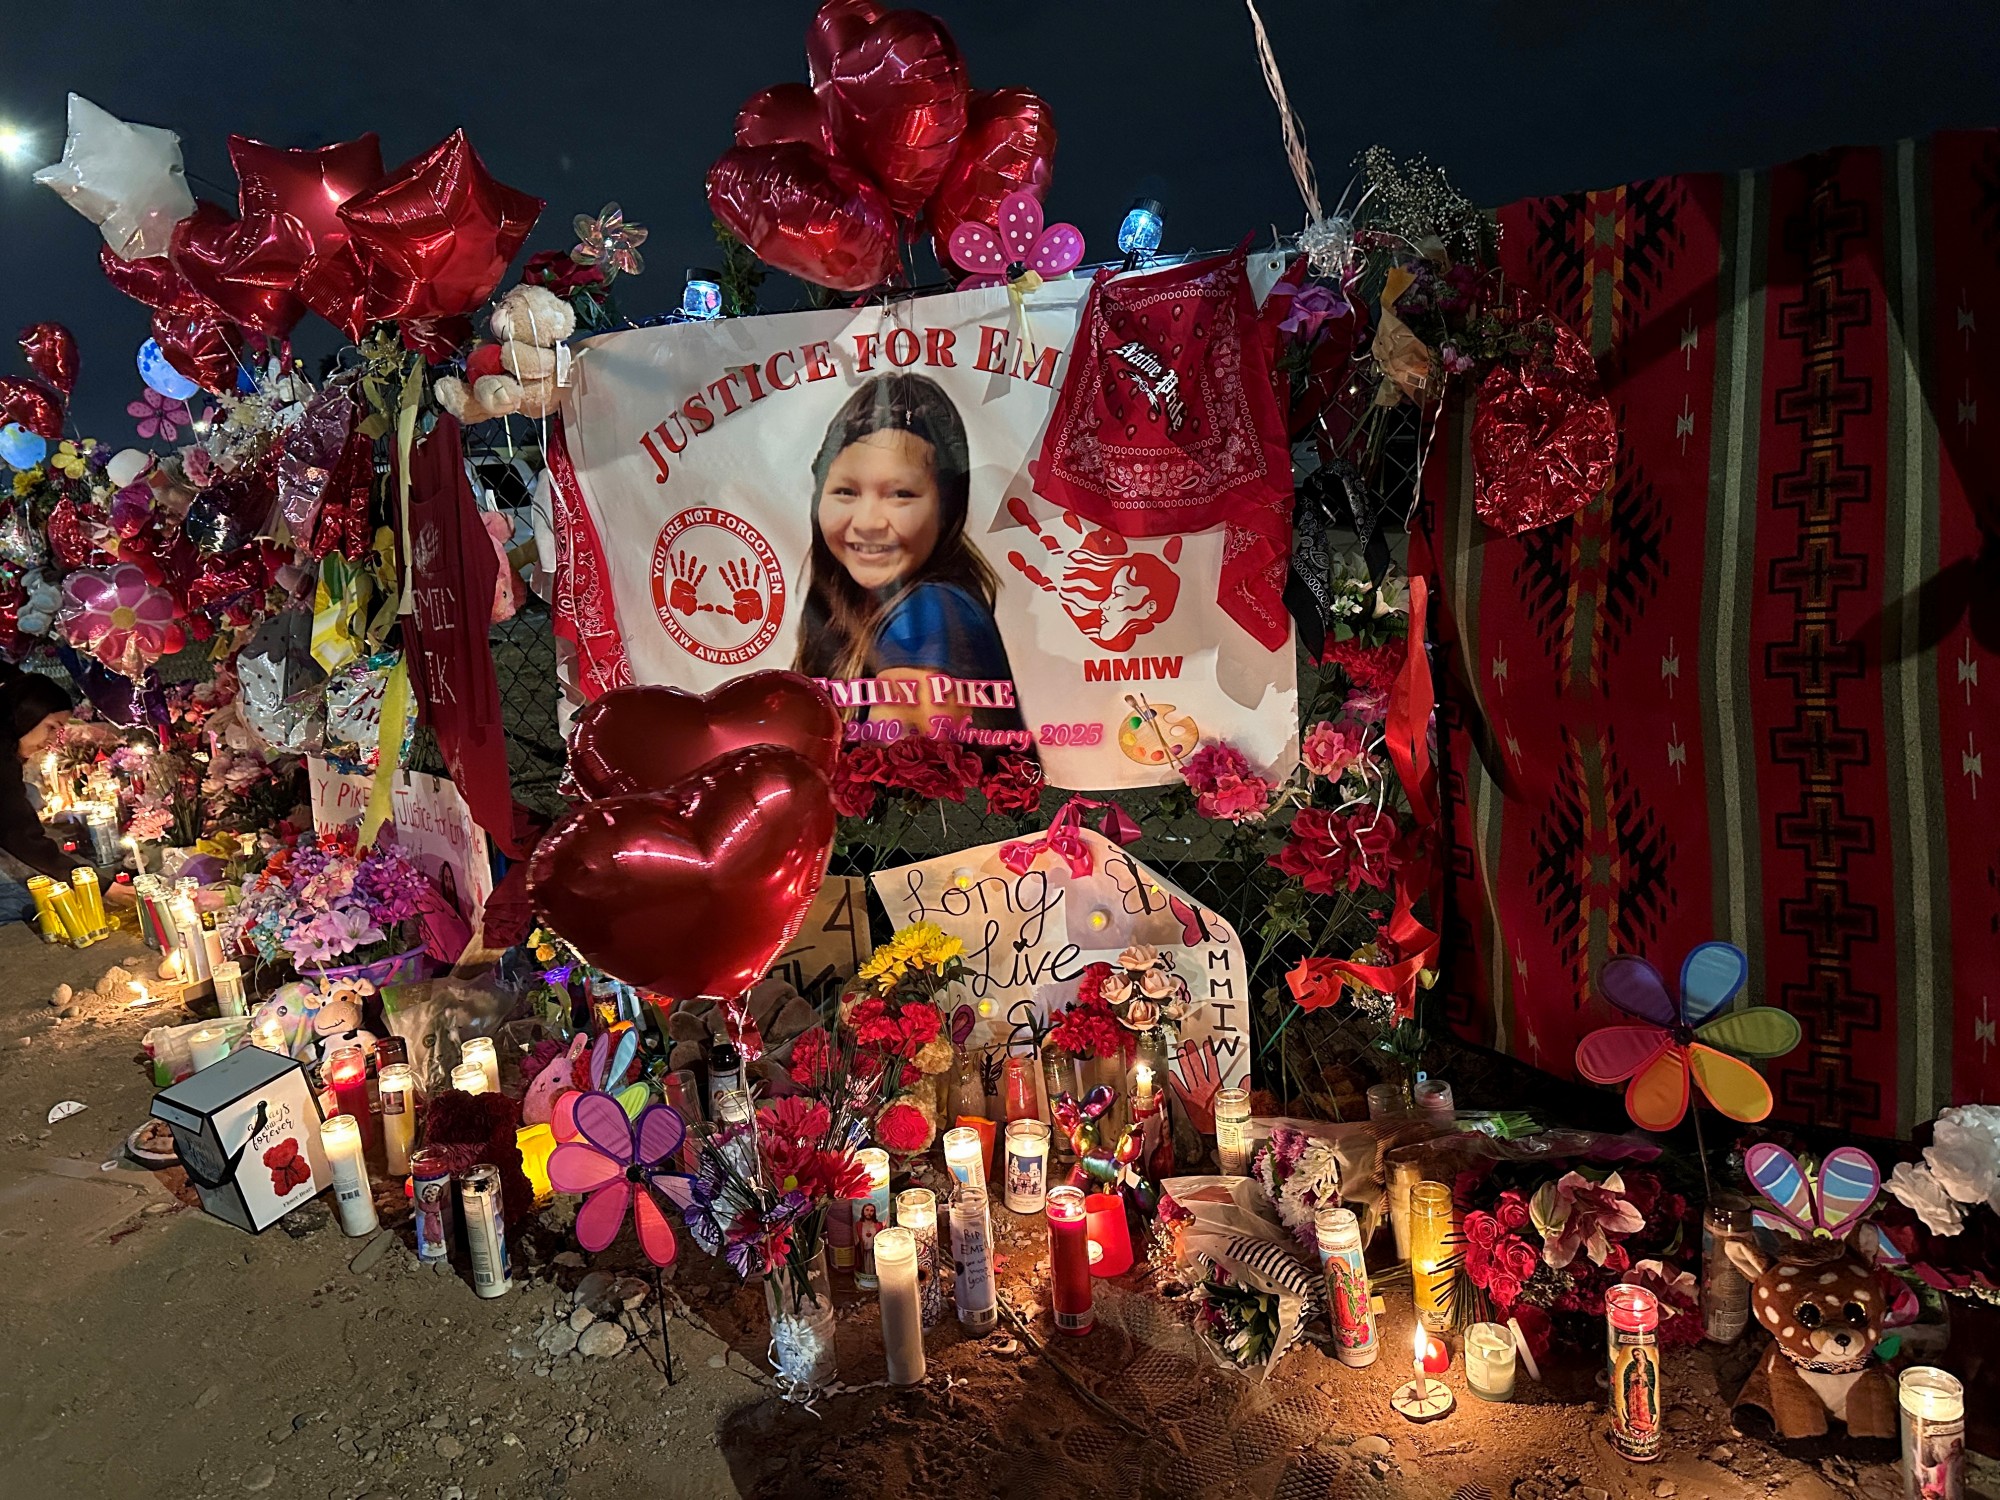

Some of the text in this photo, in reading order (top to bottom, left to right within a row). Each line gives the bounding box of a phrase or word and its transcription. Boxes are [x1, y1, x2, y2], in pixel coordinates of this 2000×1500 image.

[639, 324, 1063, 484] JUSTICE FOR EM
[1112, 341, 1184, 431] Native Pride
[653, 510, 783, 594] YOU ARE NOT FORGOTTEN
[658, 604, 777, 664] MMIW AWARENESS
[1084, 656, 1183, 682] MMIW
[812, 674, 1015, 708] MILY PIKE
[846, 721, 901, 742] 2010
[928, 715, 1033, 751] February
[1039, 723, 1104, 747] 2025
[903, 869, 1064, 948] Long
[967, 920, 1084, 997] Live
[1208, 950, 1240, 1056] MMIW
[252, 1118, 295, 1151] forever
